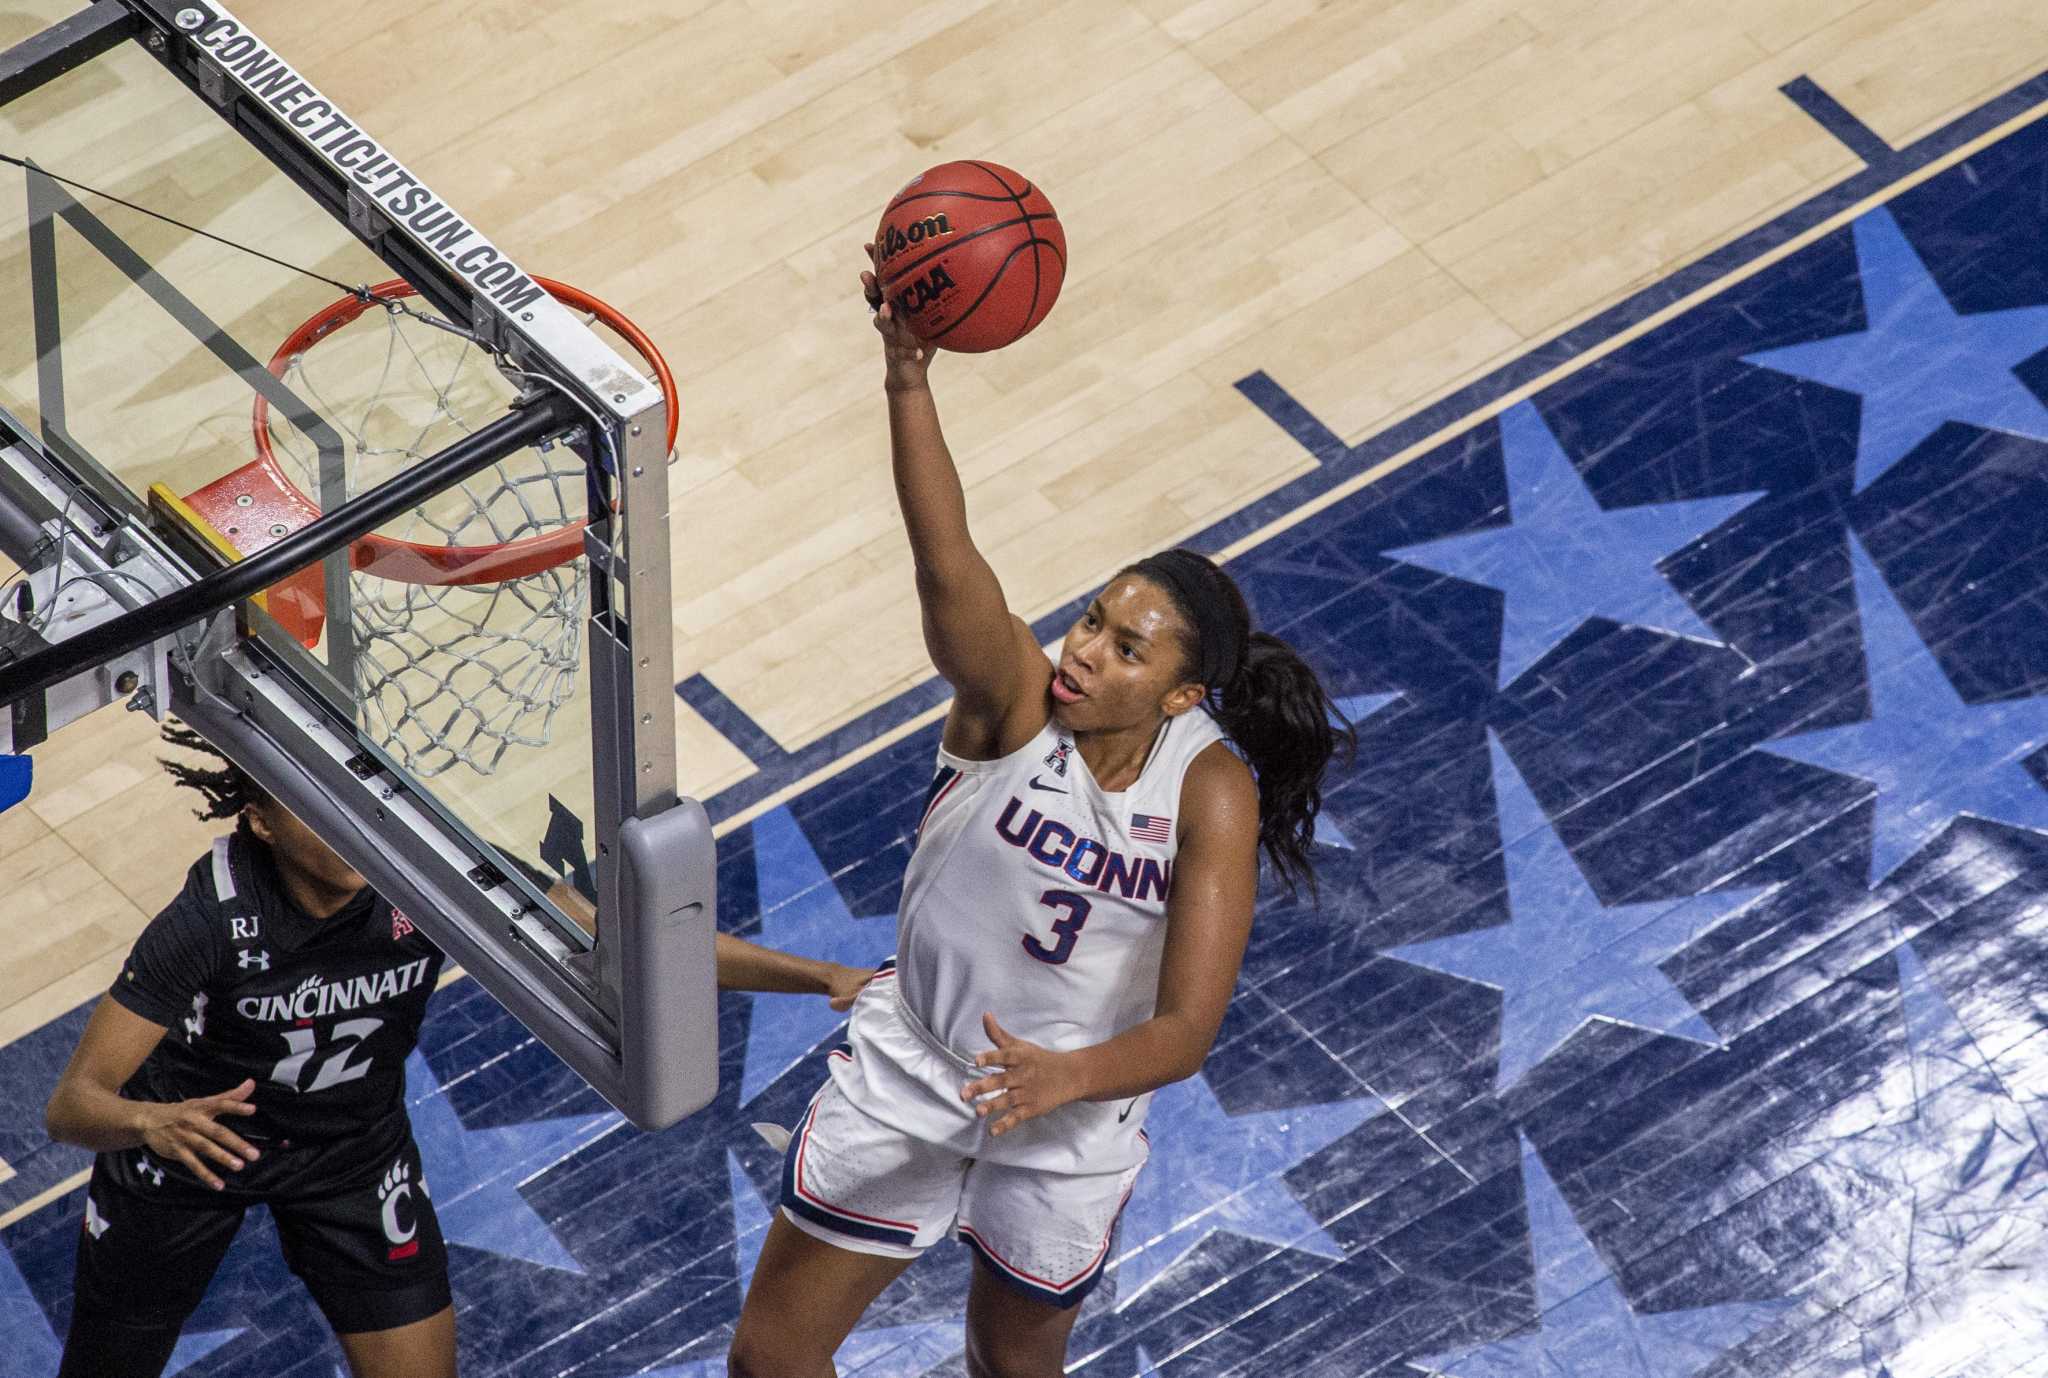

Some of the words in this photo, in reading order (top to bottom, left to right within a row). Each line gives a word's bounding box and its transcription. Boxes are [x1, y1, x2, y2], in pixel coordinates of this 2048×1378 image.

[200, 18, 546, 314] CONNECTICUTSUN.COM
[892, 263, 956, 319] CAA
[995, 796, 1171, 902] UCONN
[231, 916, 259, 940] RJ
[1022, 889, 1092, 965] 3
[237, 957, 430, 1021] CINCINNATI
[270, 1017, 384, 1093] 12
